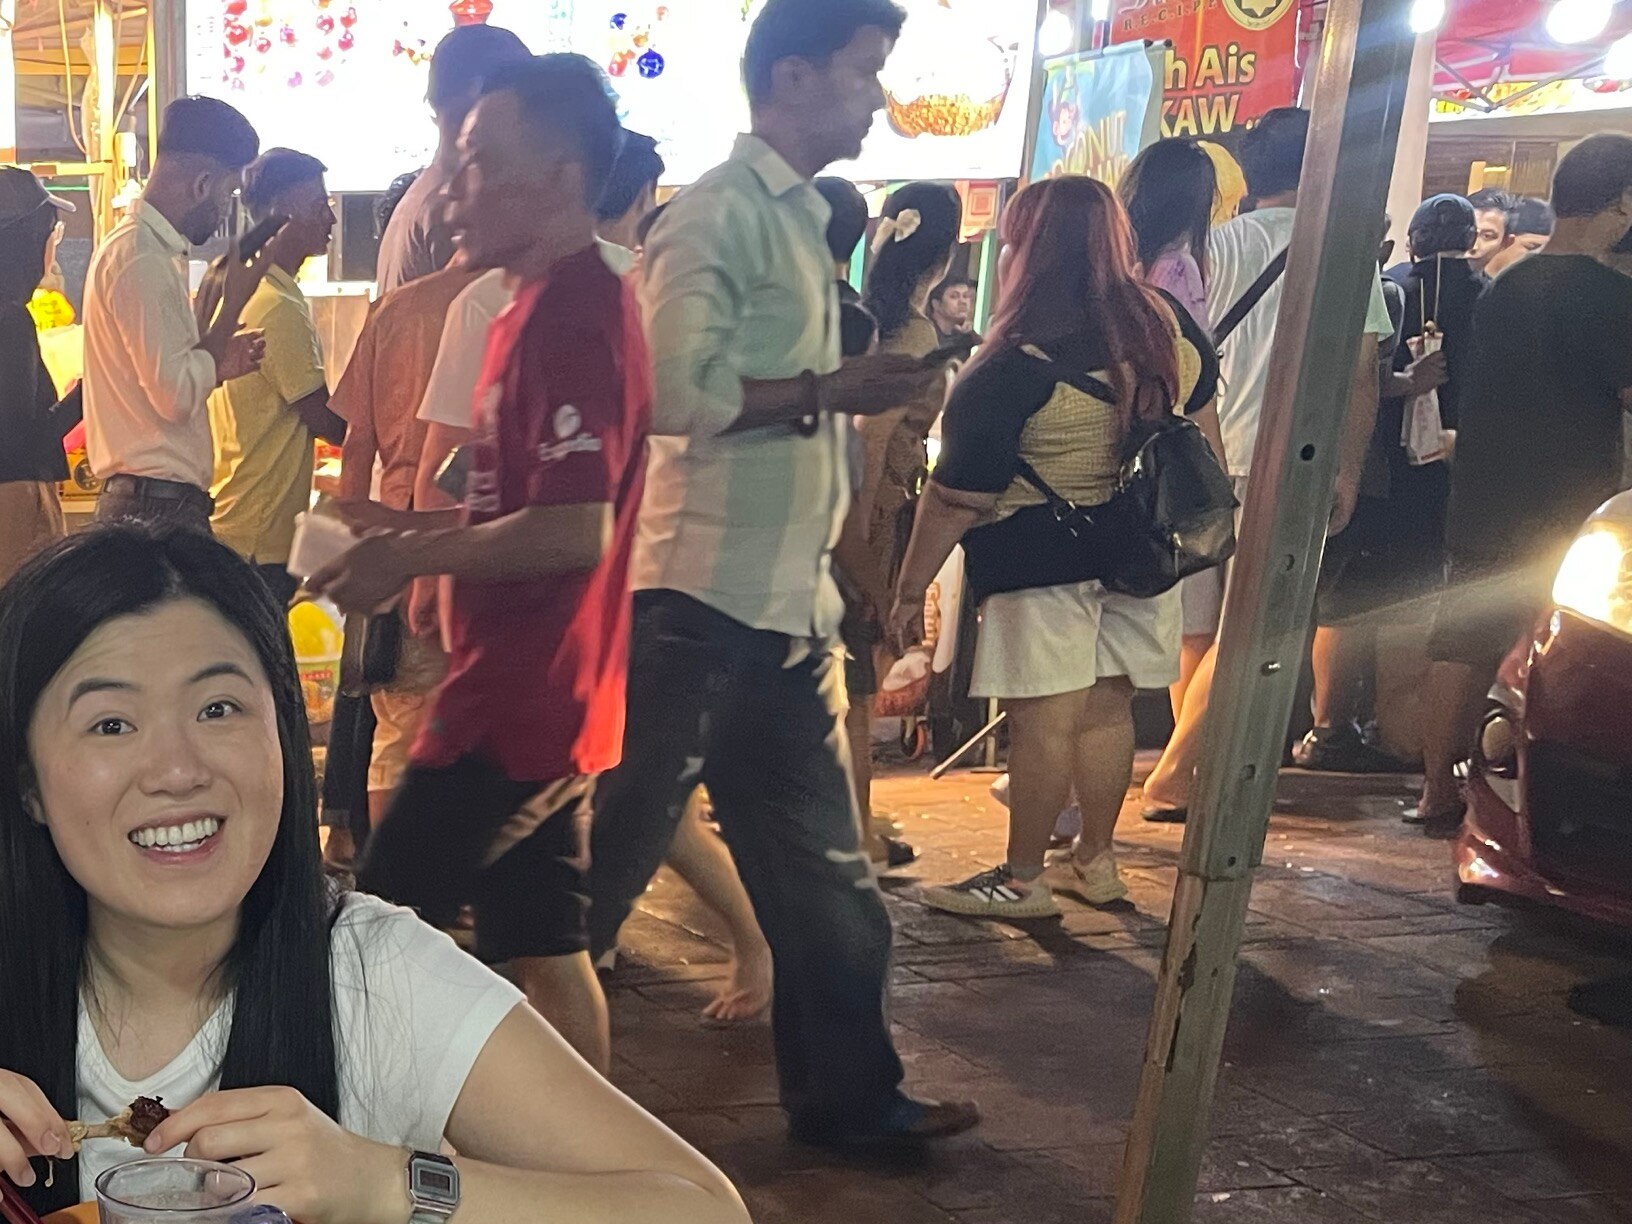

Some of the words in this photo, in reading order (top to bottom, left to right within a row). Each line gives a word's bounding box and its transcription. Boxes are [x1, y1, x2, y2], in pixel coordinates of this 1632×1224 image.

[1164, 47, 1186, 90] h
[1194, 43, 1257, 88] Ais
[1161, 93, 1240, 137] KAW
